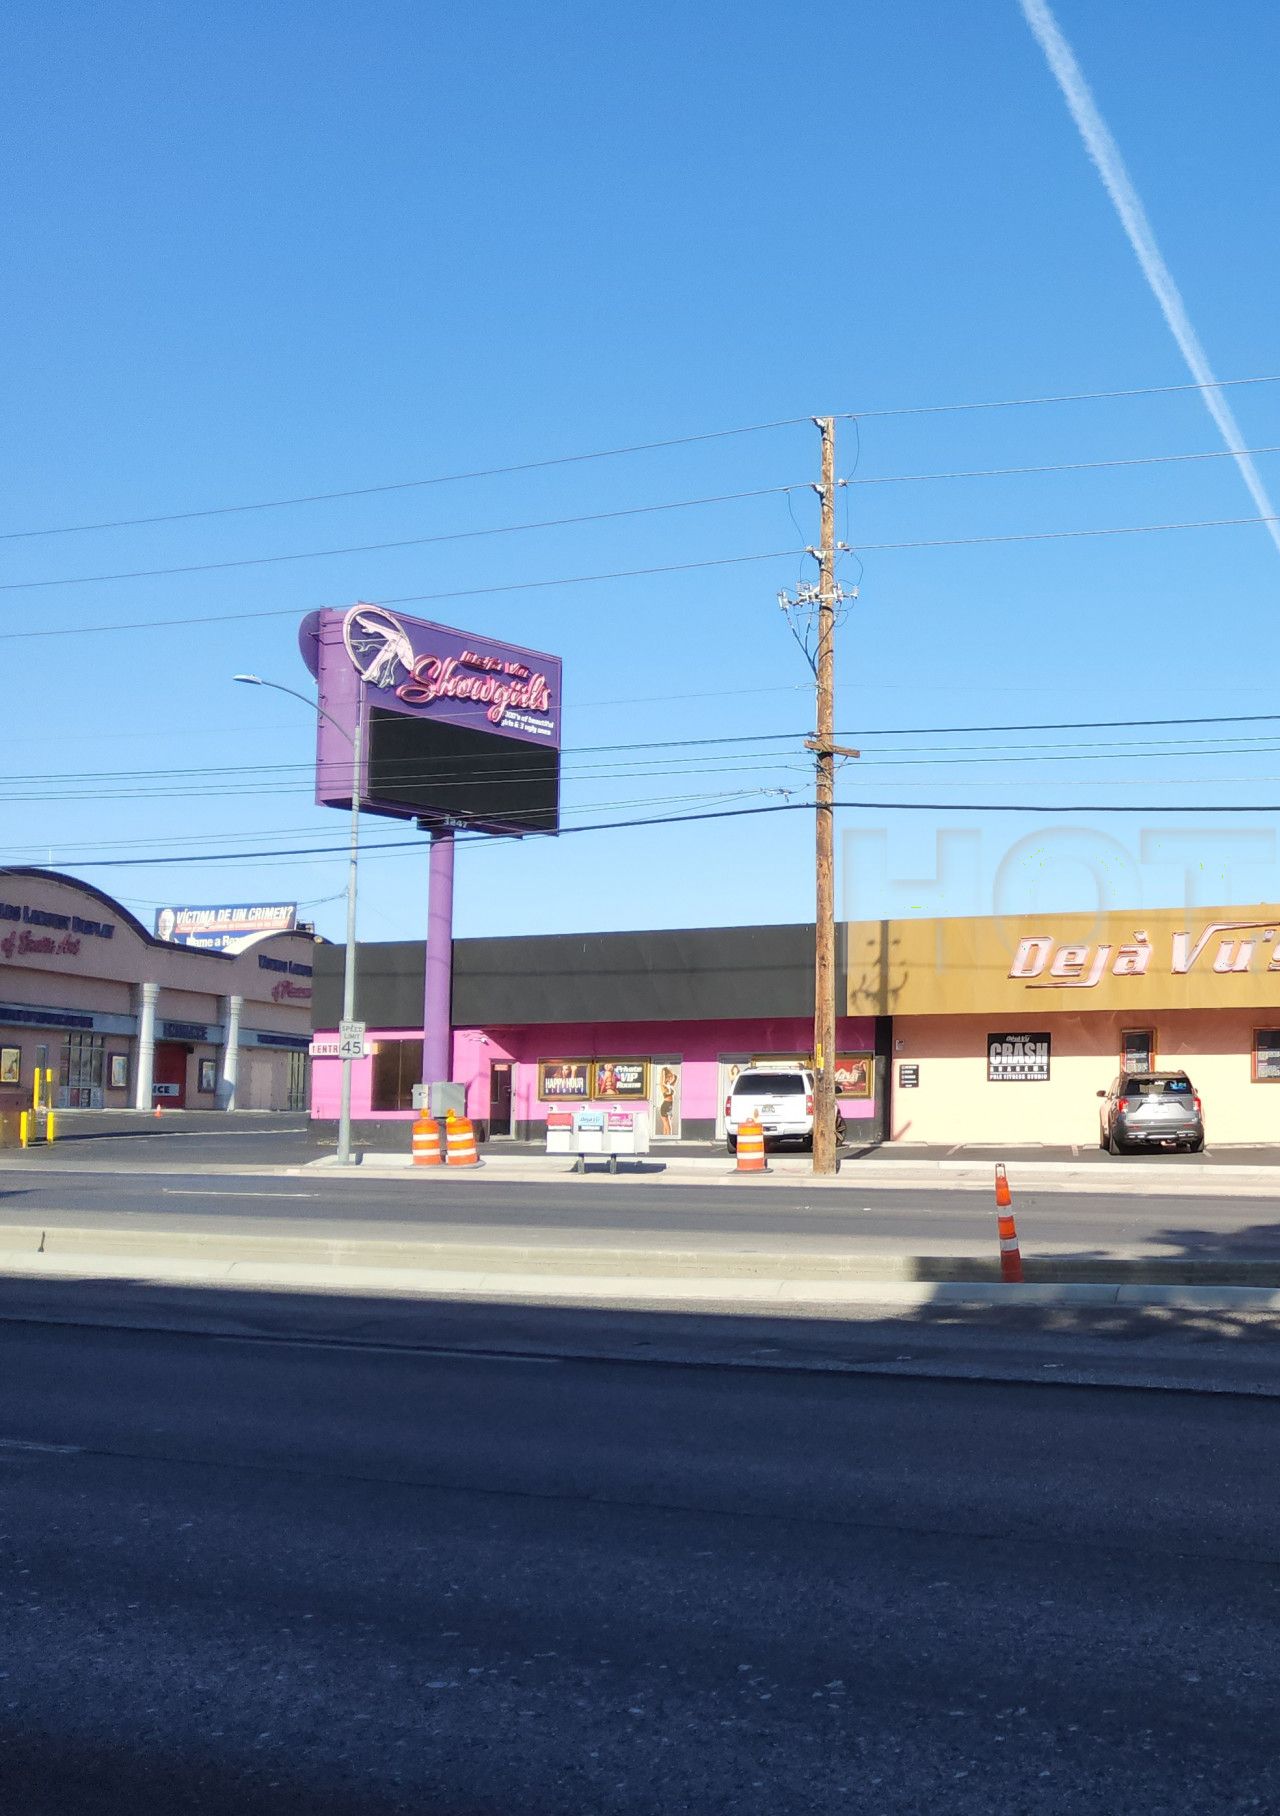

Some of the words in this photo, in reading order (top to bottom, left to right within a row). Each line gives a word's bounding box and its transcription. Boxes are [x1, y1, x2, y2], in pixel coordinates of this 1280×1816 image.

[341, 1041, 361, 1055] 45
[990, 1043, 1048, 1064] CRASH
[545, 1078, 566, 1089] HAPPY
[566, 1078, 584, 1089] HOUR
[620, 1073, 638, 1082] VIP
